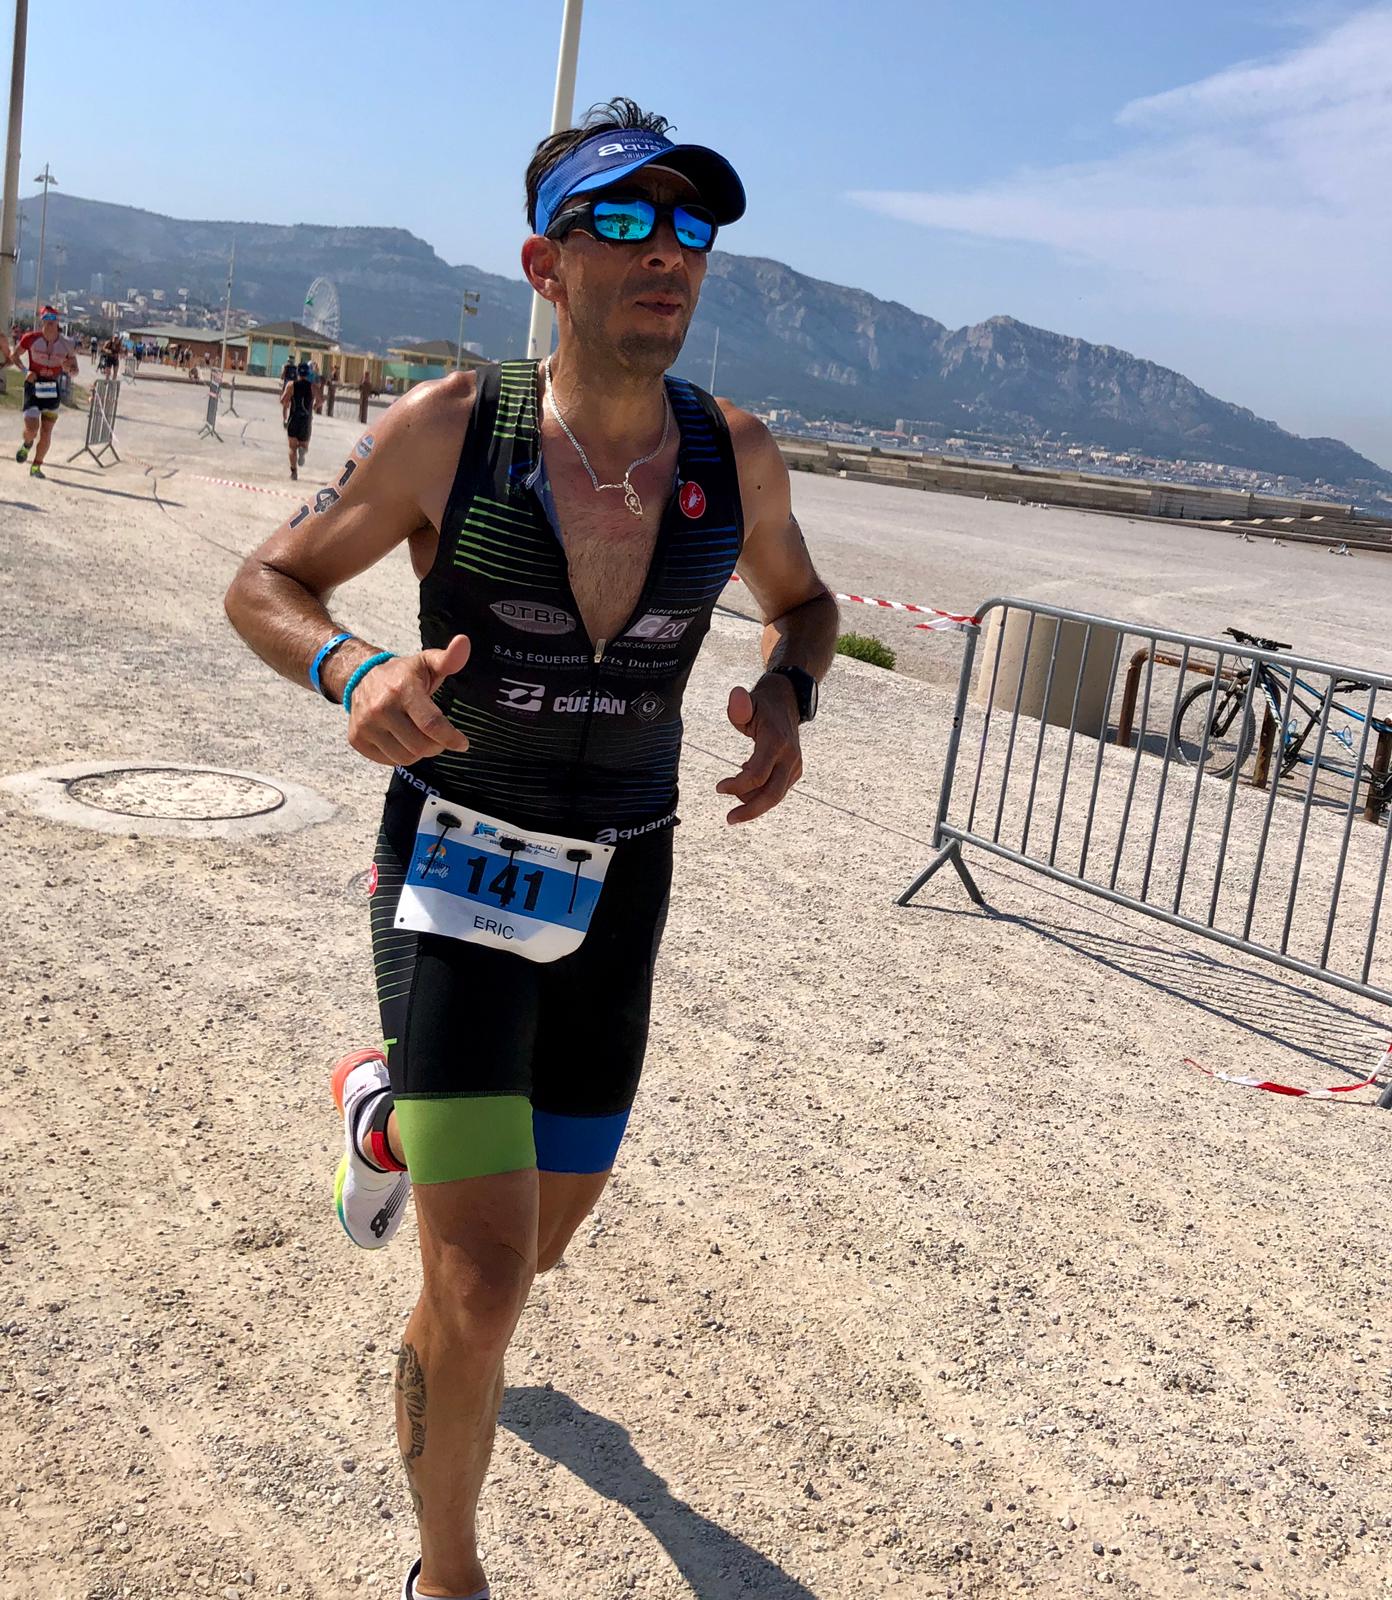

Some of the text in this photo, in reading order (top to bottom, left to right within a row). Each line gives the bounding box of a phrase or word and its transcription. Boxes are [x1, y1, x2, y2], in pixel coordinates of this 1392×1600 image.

[501, 603, 568, 625] DTBA
[527, 653, 589, 664] EQUERRE
[628, 659, 680, 669] Duchesne
[467, 855, 545, 912] 141
[473, 915, 515, 940] ERIC
